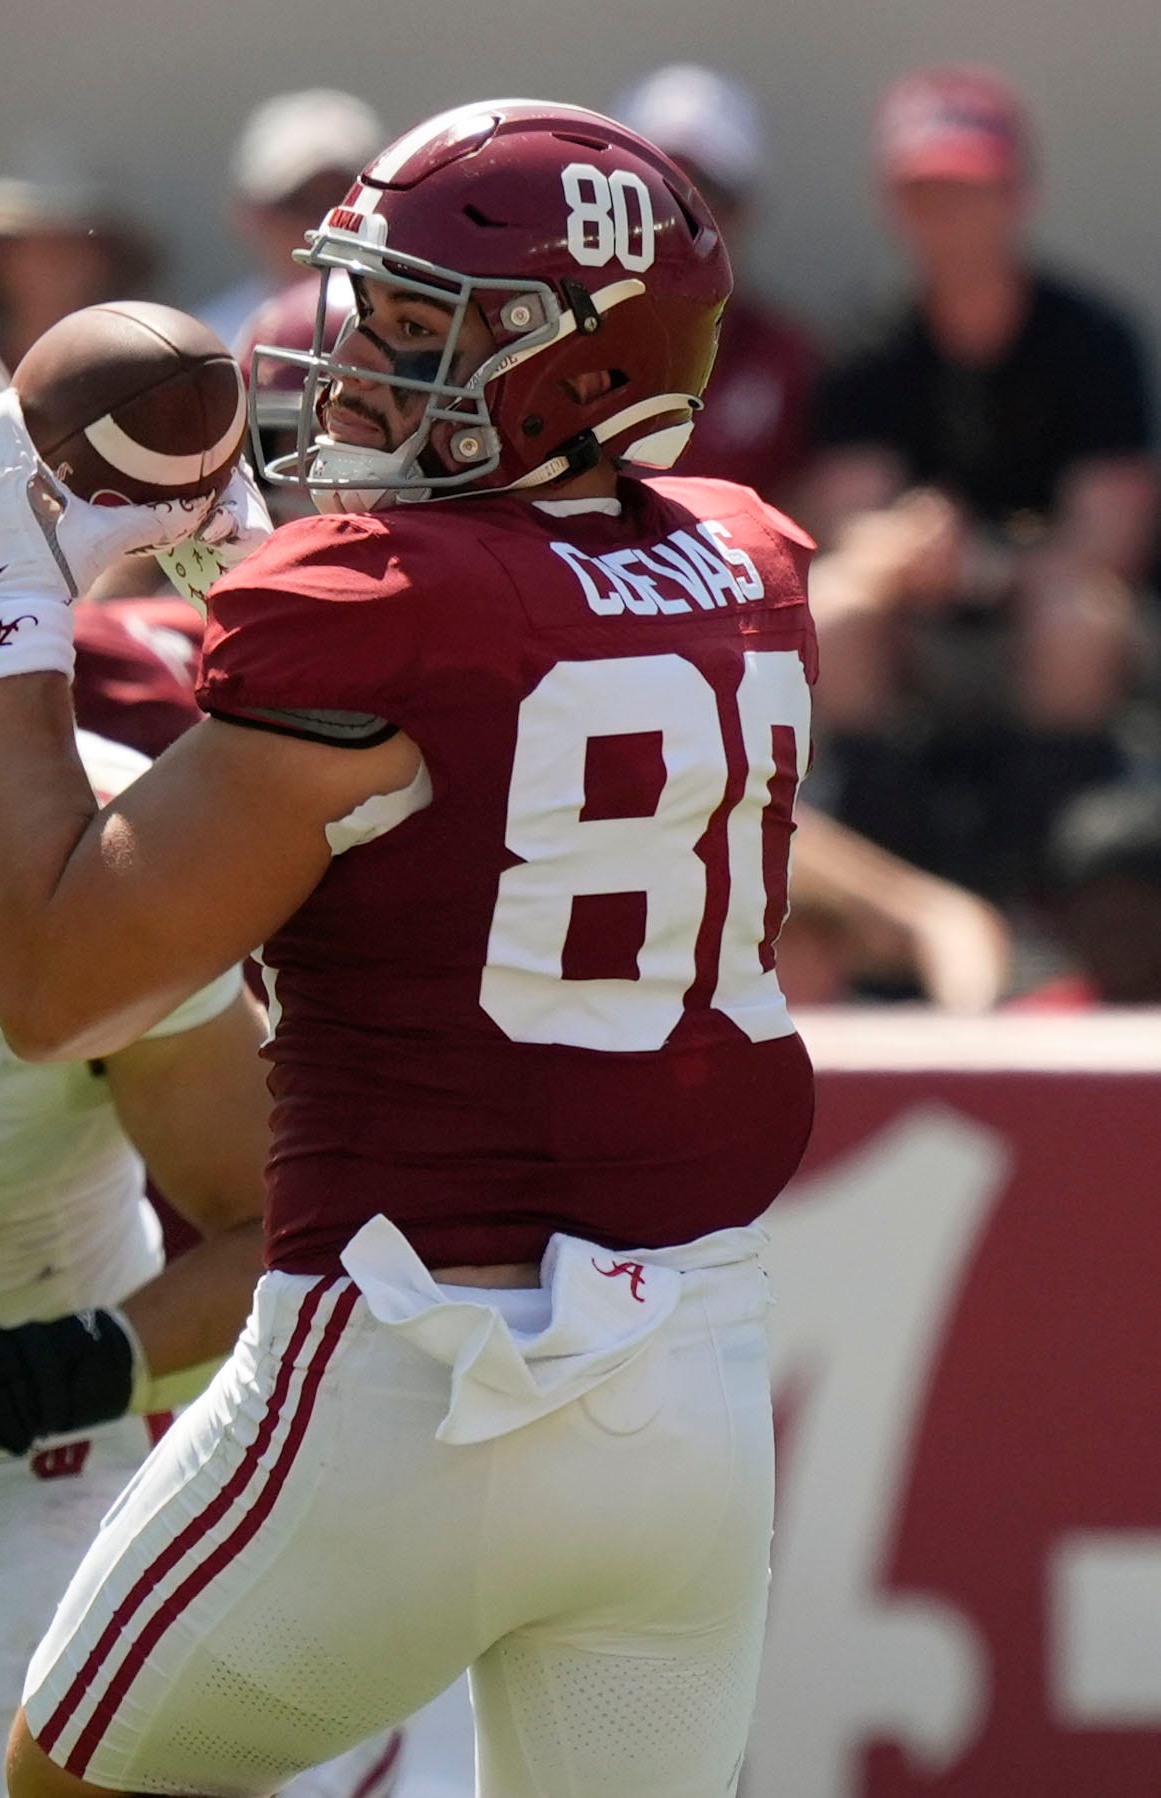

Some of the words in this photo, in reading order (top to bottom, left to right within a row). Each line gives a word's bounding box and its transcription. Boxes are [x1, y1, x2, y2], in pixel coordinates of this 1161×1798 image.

[561, 164, 655, 272] 80
[549, 520, 765, 616] CUEVAS
[479, 650, 813, 1052] 80
